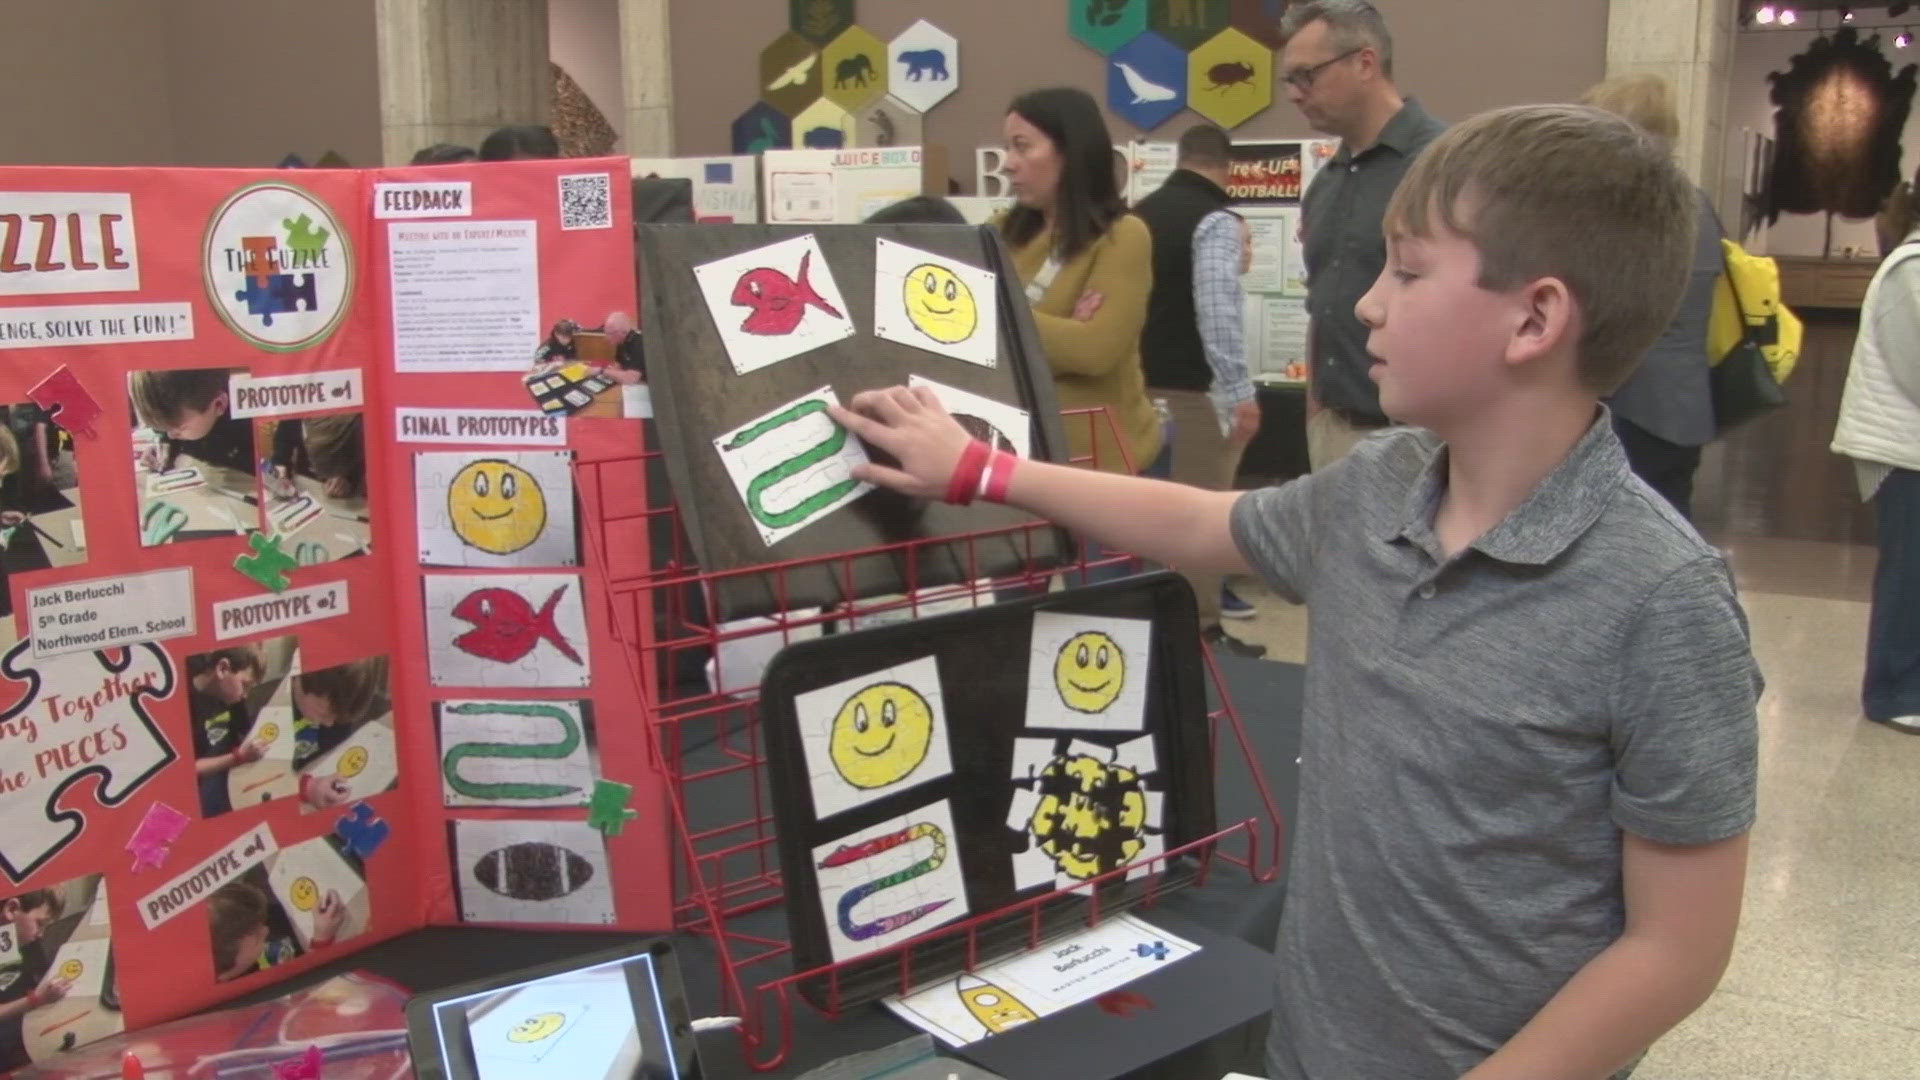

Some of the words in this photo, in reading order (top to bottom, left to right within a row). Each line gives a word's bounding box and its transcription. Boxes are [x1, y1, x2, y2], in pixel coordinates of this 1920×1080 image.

[383, 190, 463, 211] FEEDBACK
[224, 248, 257, 272] THE
[266, 247, 331, 271] FUZZLE
[45, 320, 93, 339] SOLVE
[101, 319, 126, 336] THE
[237, 382, 326, 410] PROTOTYPE
[402, 415, 450, 436] FINAL
[457, 415, 559, 438] PROTOTYPES
[33, 593, 62, 608] Jack
[64, 582, 125, 603] Berlucchi
[38, 615, 55, 629] 5th
[58, 610, 98, 626] Grade
[222, 594, 311, 631] PROTOTYPE
[37, 629, 106, 651] Northwood
[108, 626, 143, 640] Elem.
[146, 616, 186, 634] School
[42, 671, 157, 723] Together
[35, 723, 127, 779] PIECES
[147, 849, 242, 921] PROTOTYPE
